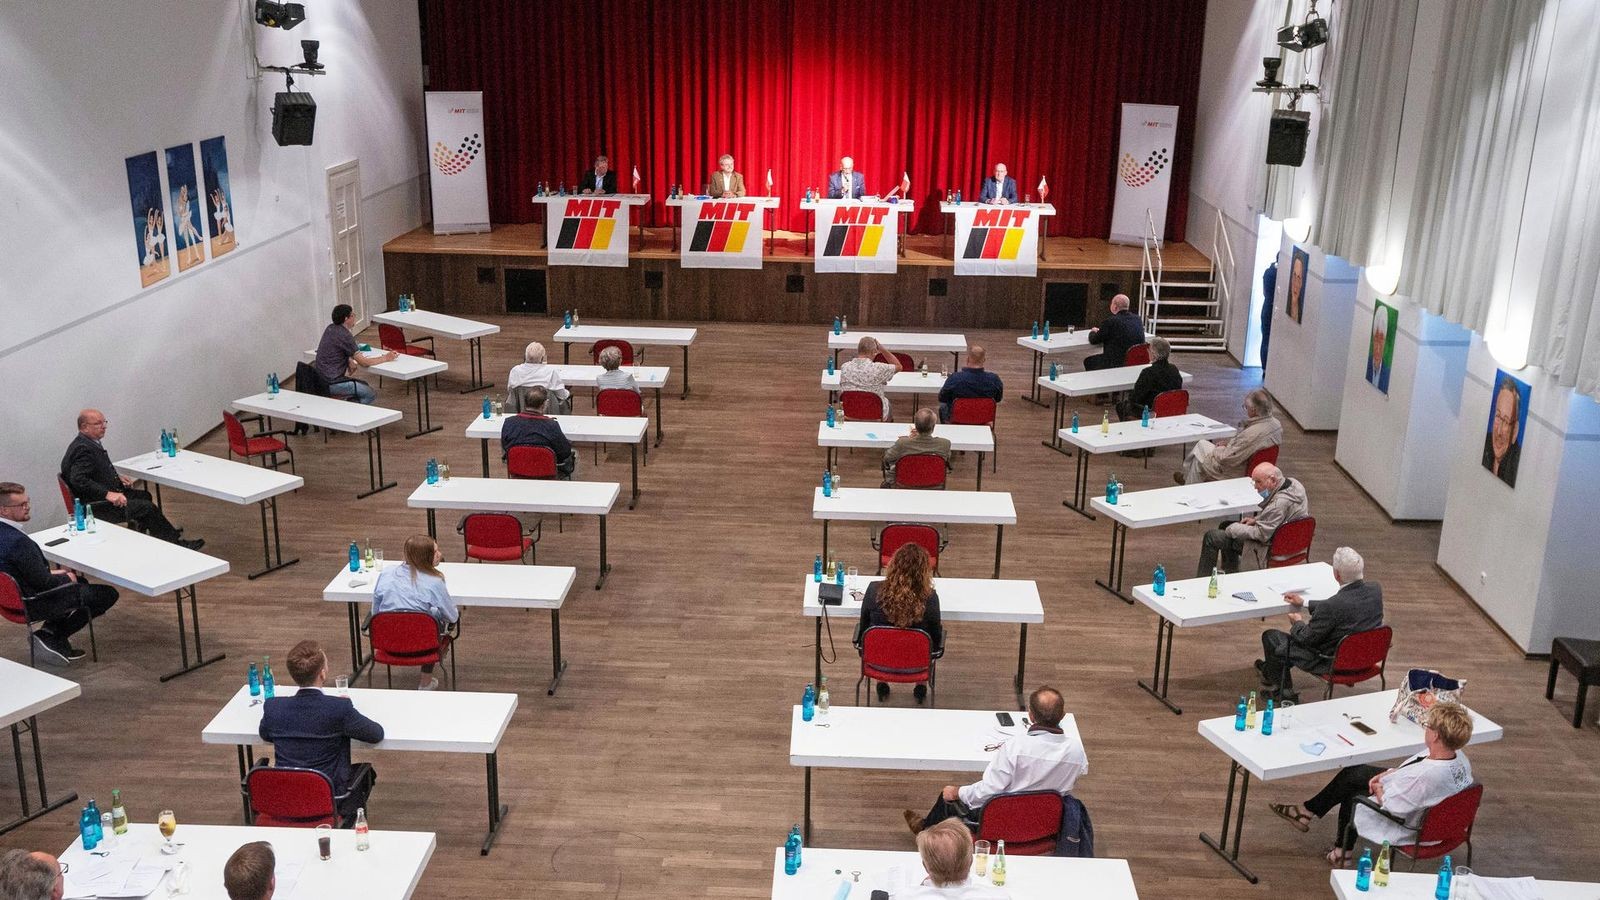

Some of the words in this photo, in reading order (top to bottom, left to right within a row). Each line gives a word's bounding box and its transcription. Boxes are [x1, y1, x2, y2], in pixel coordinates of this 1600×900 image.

[564, 199, 621, 217] MIT
[698, 203, 756, 220] MIT
[832, 206, 890, 225] MIT
[972, 209, 1030, 227] MIT
